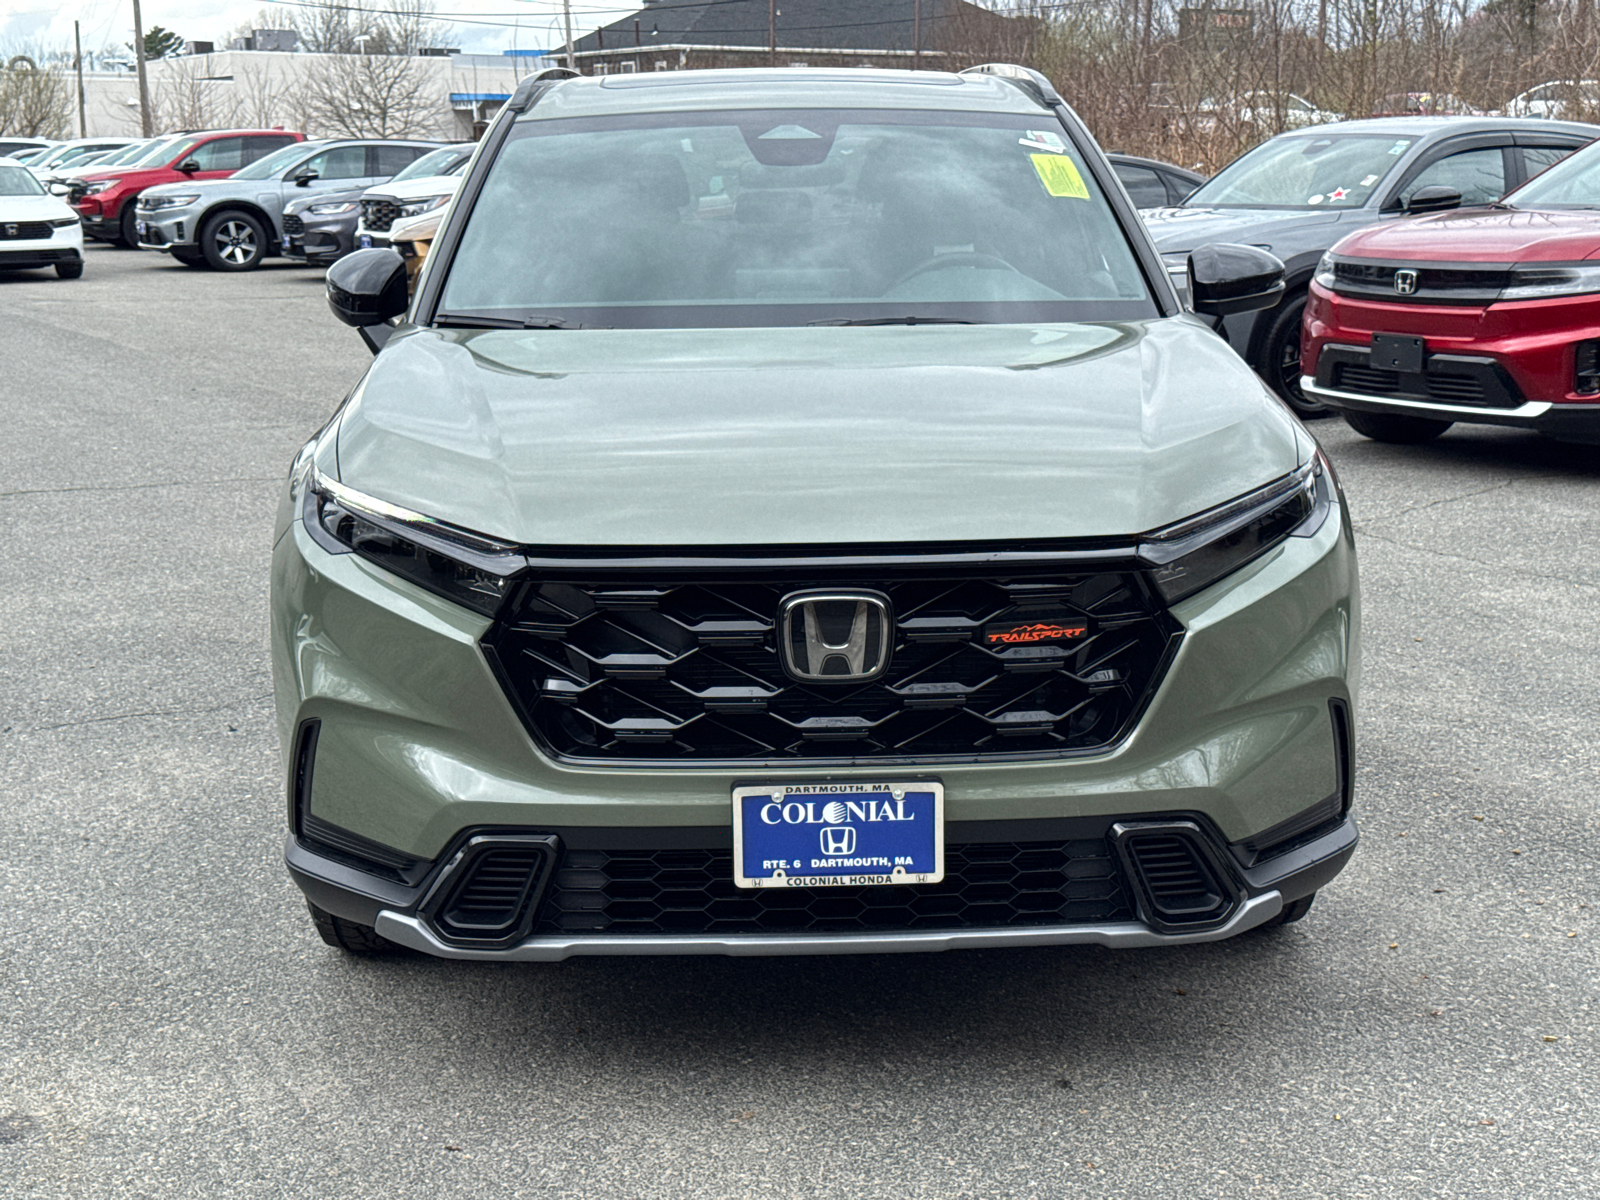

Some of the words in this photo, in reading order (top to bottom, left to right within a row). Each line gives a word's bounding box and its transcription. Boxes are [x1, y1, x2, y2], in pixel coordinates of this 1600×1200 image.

[988, 627, 1085, 643] TRAILSPORT
[872, 784, 891, 792] MA
[760, 800, 915, 825] COLONIAL
[763, 860, 790, 869] RTE.
[793, 859, 802, 869] 6
[811, 857, 891, 868] DARTMOUTH,
[894, 856, 914, 866] MA
[786, 876, 846, 887] COLONIAL
[849, 875, 893, 885] HONDA
